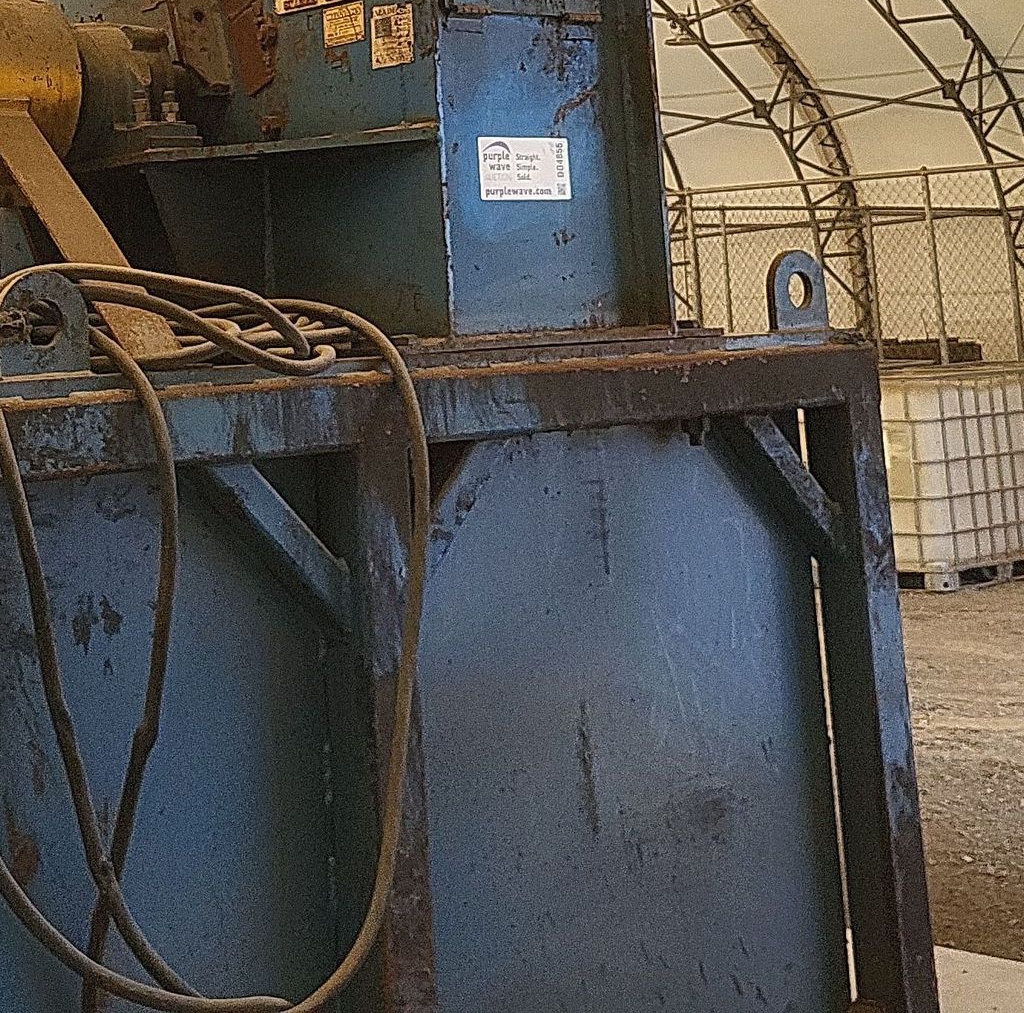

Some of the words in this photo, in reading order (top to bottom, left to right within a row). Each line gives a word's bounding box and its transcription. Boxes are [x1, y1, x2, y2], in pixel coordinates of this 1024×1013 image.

[483, 150, 510, 162] purple
[515, 153, 541, 162] Straight.
[489, 163, 511, 171] wave
[516, 163, 539, 172] Simple.
[485, 186, 552, 198] purplewave.com
